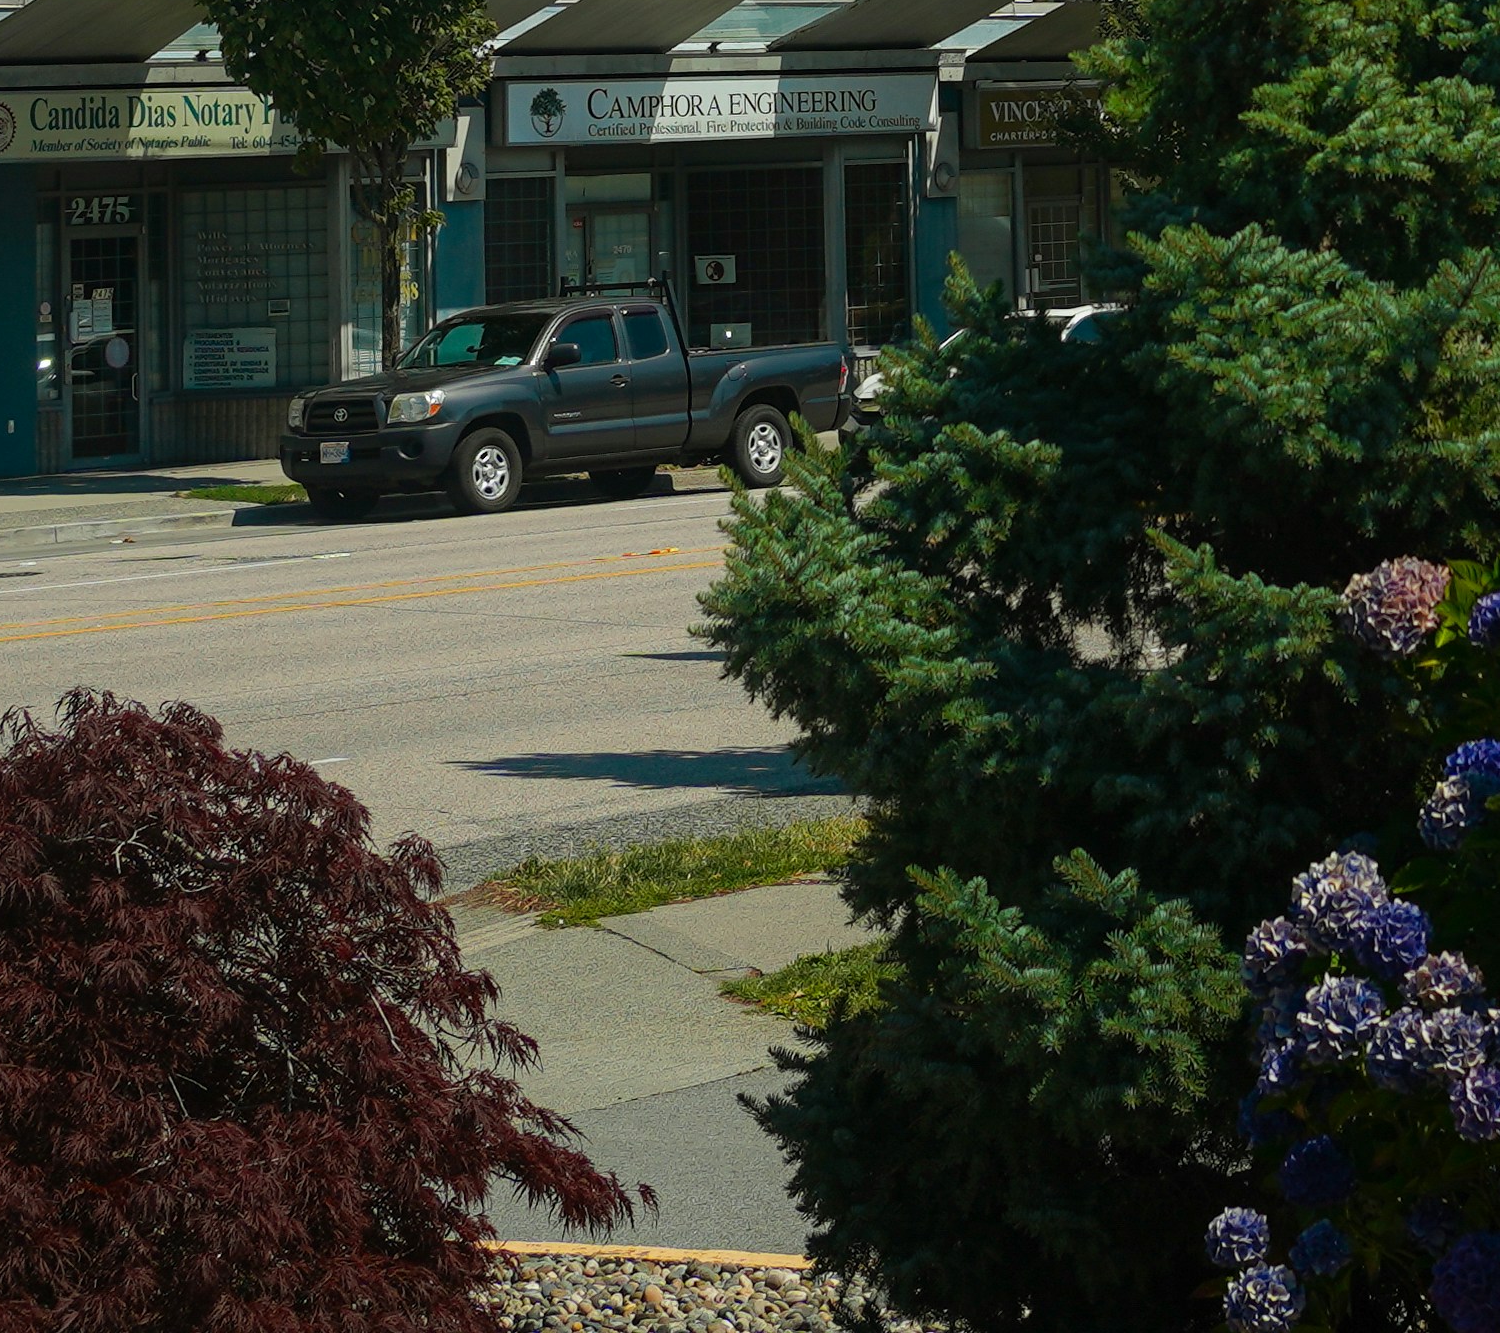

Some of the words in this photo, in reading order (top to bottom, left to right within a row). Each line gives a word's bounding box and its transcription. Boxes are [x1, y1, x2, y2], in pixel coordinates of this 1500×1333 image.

[587, 88, 722, 120] CAMPHORA
[729, 89, 877, 115] ENGINEERING
[30, 96, 120, 132] Candida
[127, 95, 177, 129] Dias
[182, 94, 257, 134] Notary
[588, 122, 636, 137] Certified
[706, 120, 728, 134] Fire
[730, 117, 780, 133] Protection
[783, 118, 793, 131] &
[796, 116, 838, 132] Building
[840, 115, 867, 129] Code
[869, 113, 921, 130] Consulting
[30, 138, 73, 153] Member
[75, 137, 86, 151] of
[86, 136, 124, 152] Society
[125, 135, 138, 151] of
[138, 135, 179, 150] Notaries
[181, 134, 212, 149] Public
[70, 195, 131, 226] 2475
[197, 231, 228, 241] Wills
[197, 244, 233, 253] Power
[240, 242, 251, 252] of
[197, 255, 260, 266] Mortgages
[196, 268, 269, 279] Conveyance
